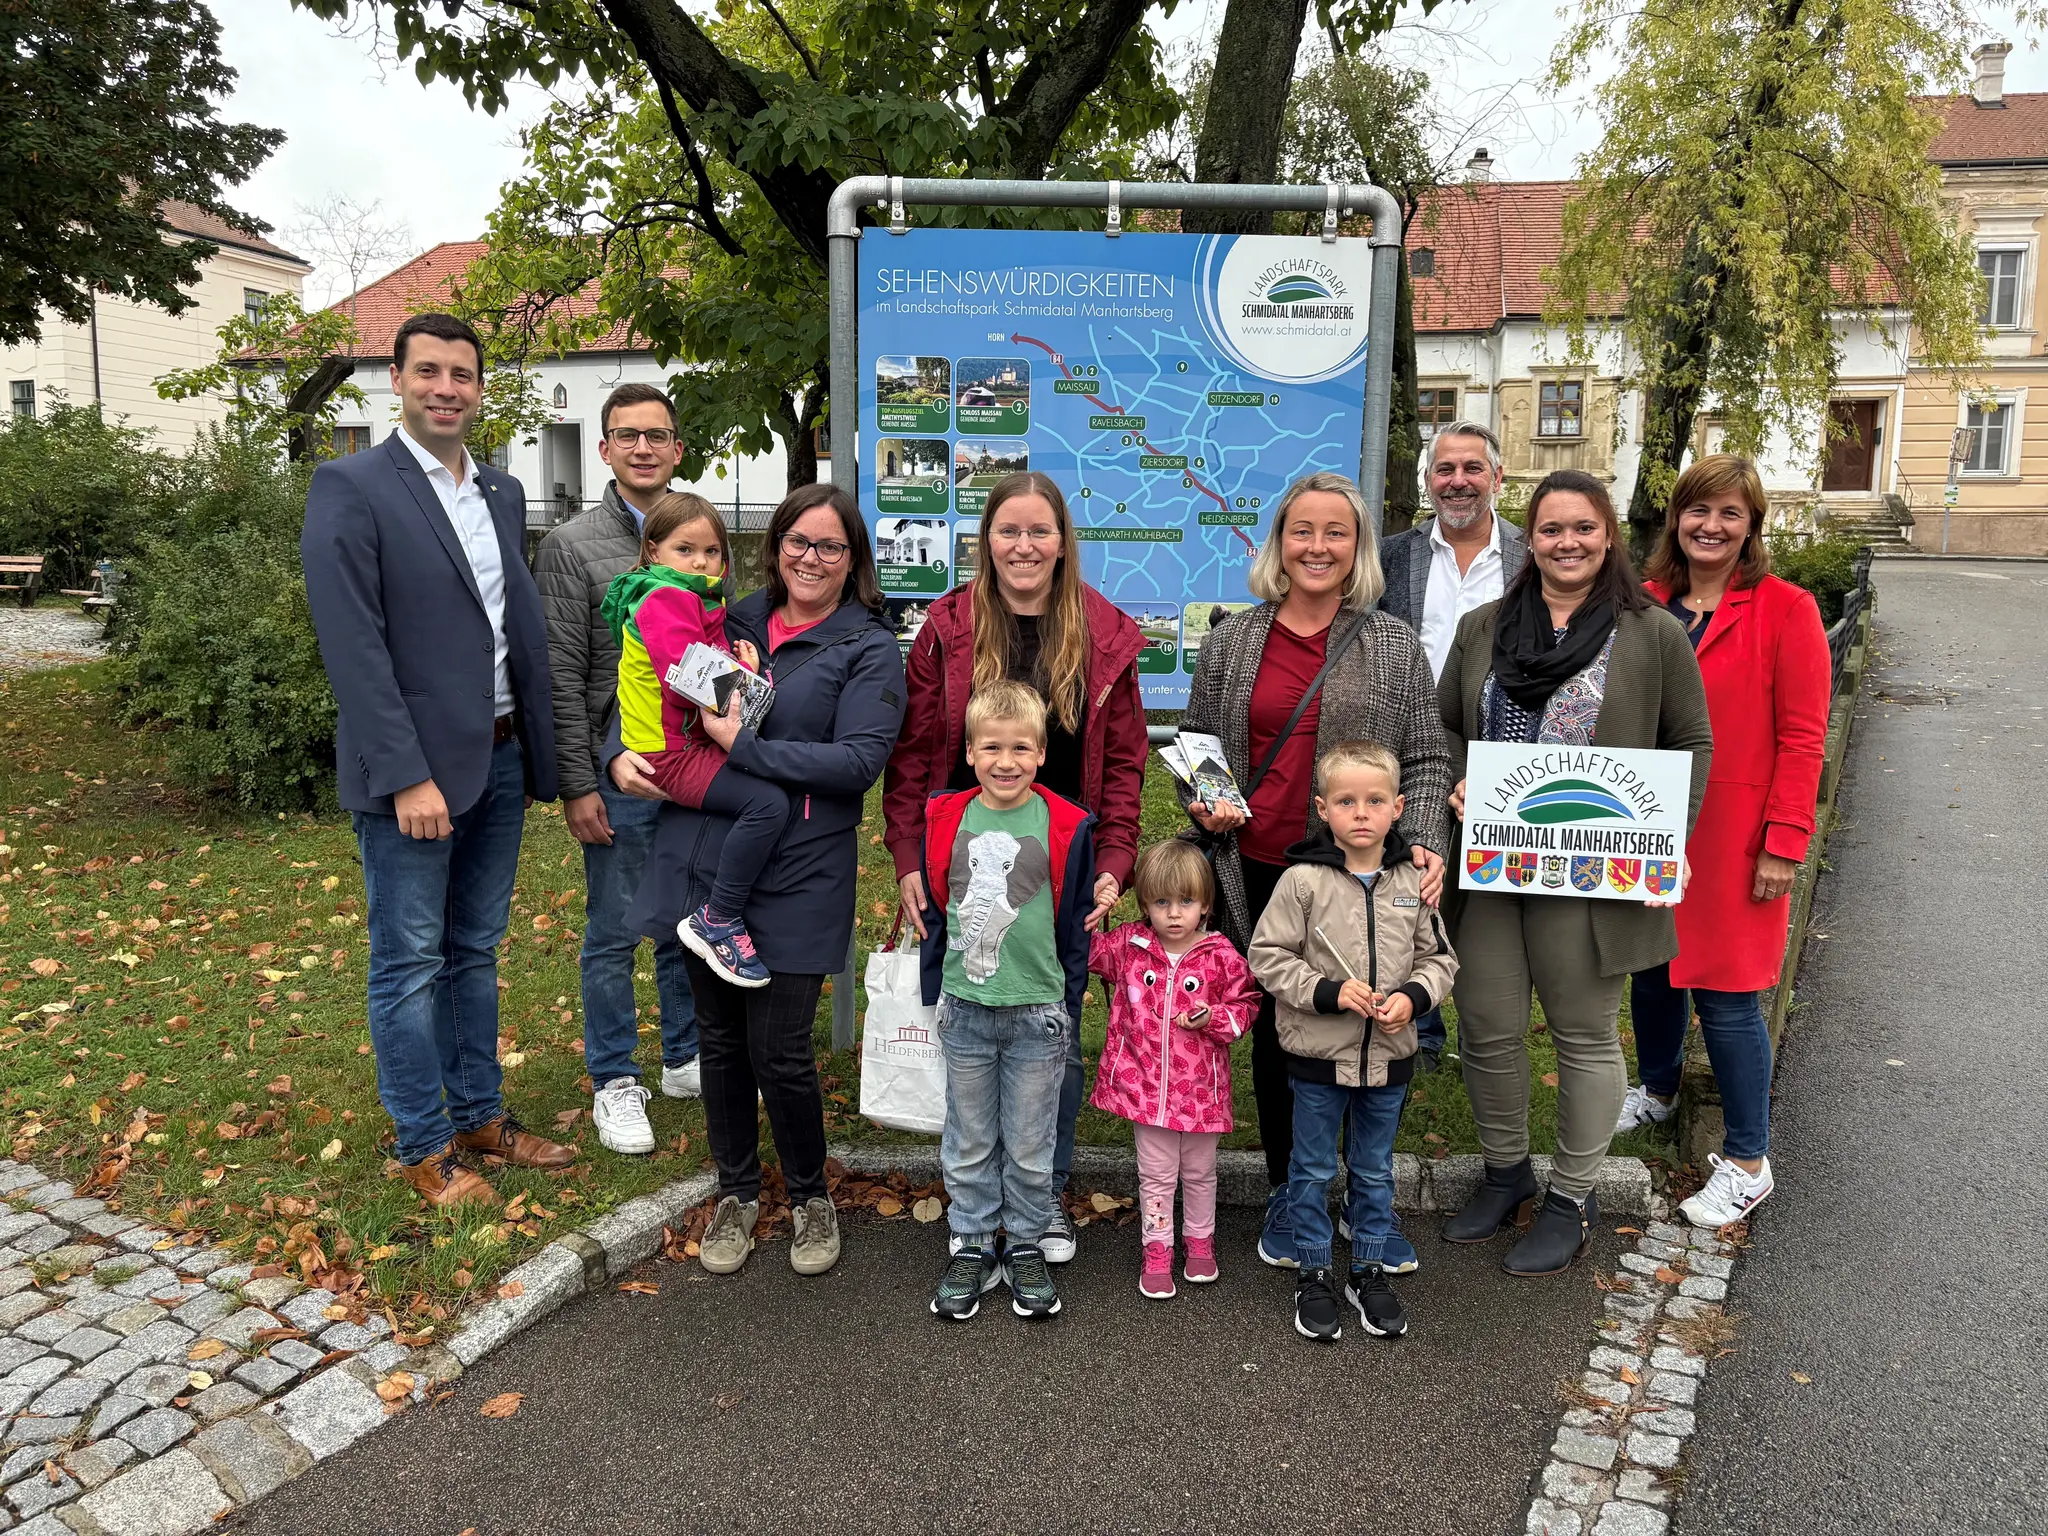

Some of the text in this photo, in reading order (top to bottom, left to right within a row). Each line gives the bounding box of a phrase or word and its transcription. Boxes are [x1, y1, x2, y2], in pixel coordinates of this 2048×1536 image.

[876, 266, 1175, 298] SEHENSWÜRDIGKEITEN
[1248, 258, 1348, 299] LANDSCHAFTSPARK
[876, 298, 1173, 323] im Landschaftspark Schmidatal Manhartsberg
[1241, 303, 1354, 321] SCHMIDATAL MANHARTSBERG
[1241, 322, 1352, 337] www.schmidatal.at
[987, 332, 1005, 343] HORN
[1056, 383, 1097, 393] MAISSAU
[1210, 394, 1261, 405] SITZENDORF
[960, 409, 1002, 418] SCHLOSS MAISSAU
[1091, 418, 1143, 429] RAVELSBACH
[1141, 457, 1185, 468] ZIERSDORF
[959, 497, 976, 505] KIRCHE
[1201, 515, 1255, 525] HELDENBERG
[1074, 529, 1180, 541] OHENWARTH MÜHLBACH
[1248, 548, 1257, 558] B4
[1148, 684, 1174, 695] unter
[1484, 751, 1665, 821] LANDSCHAFTSPARK
[1471, 823, 1675, 857] SCHMIDATAL MANHARTSBERG
